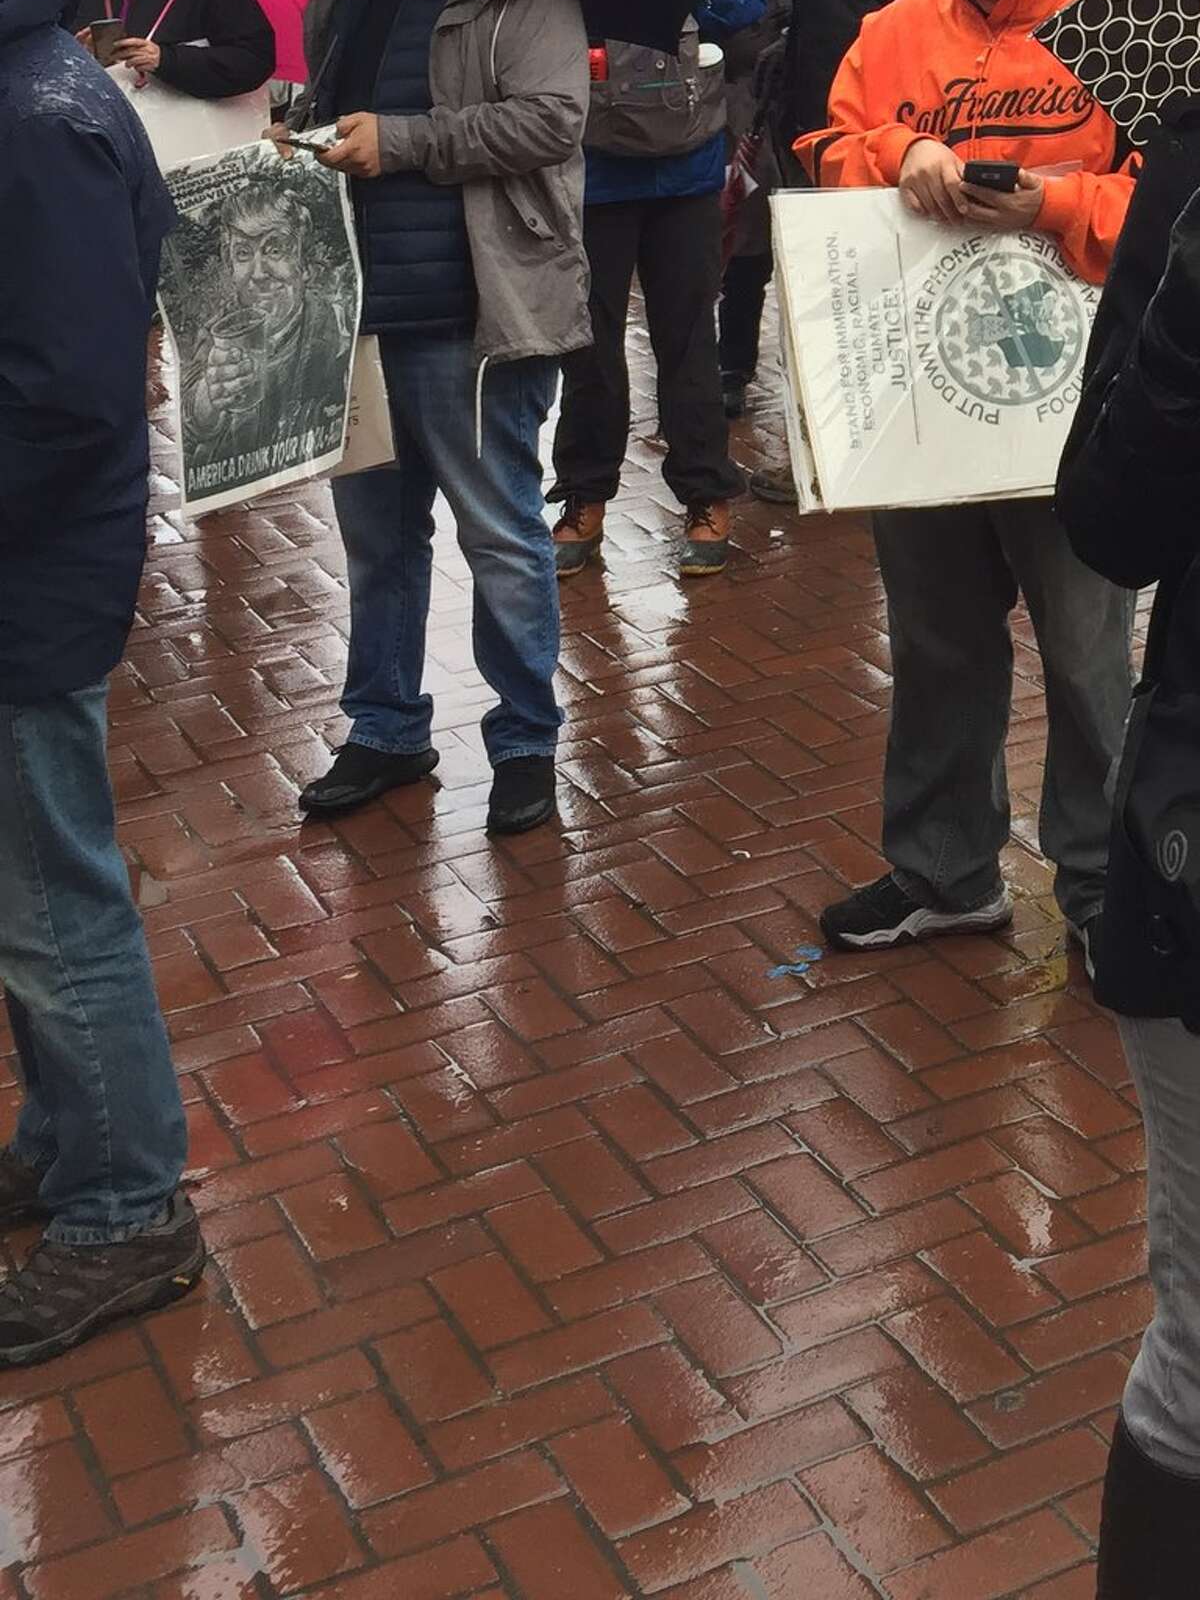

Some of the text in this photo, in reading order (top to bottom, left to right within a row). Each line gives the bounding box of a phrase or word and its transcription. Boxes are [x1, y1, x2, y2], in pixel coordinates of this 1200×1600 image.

[896, 77, 1095, 135] San Francisco
[870, 301, 885, 373] CLIMATE
[882, 288, 906, 390] JUSTICE!
[913, 235, 1000, 425] PUT DOWN THE PHONE
[838, 353, 852, 387] FOR
